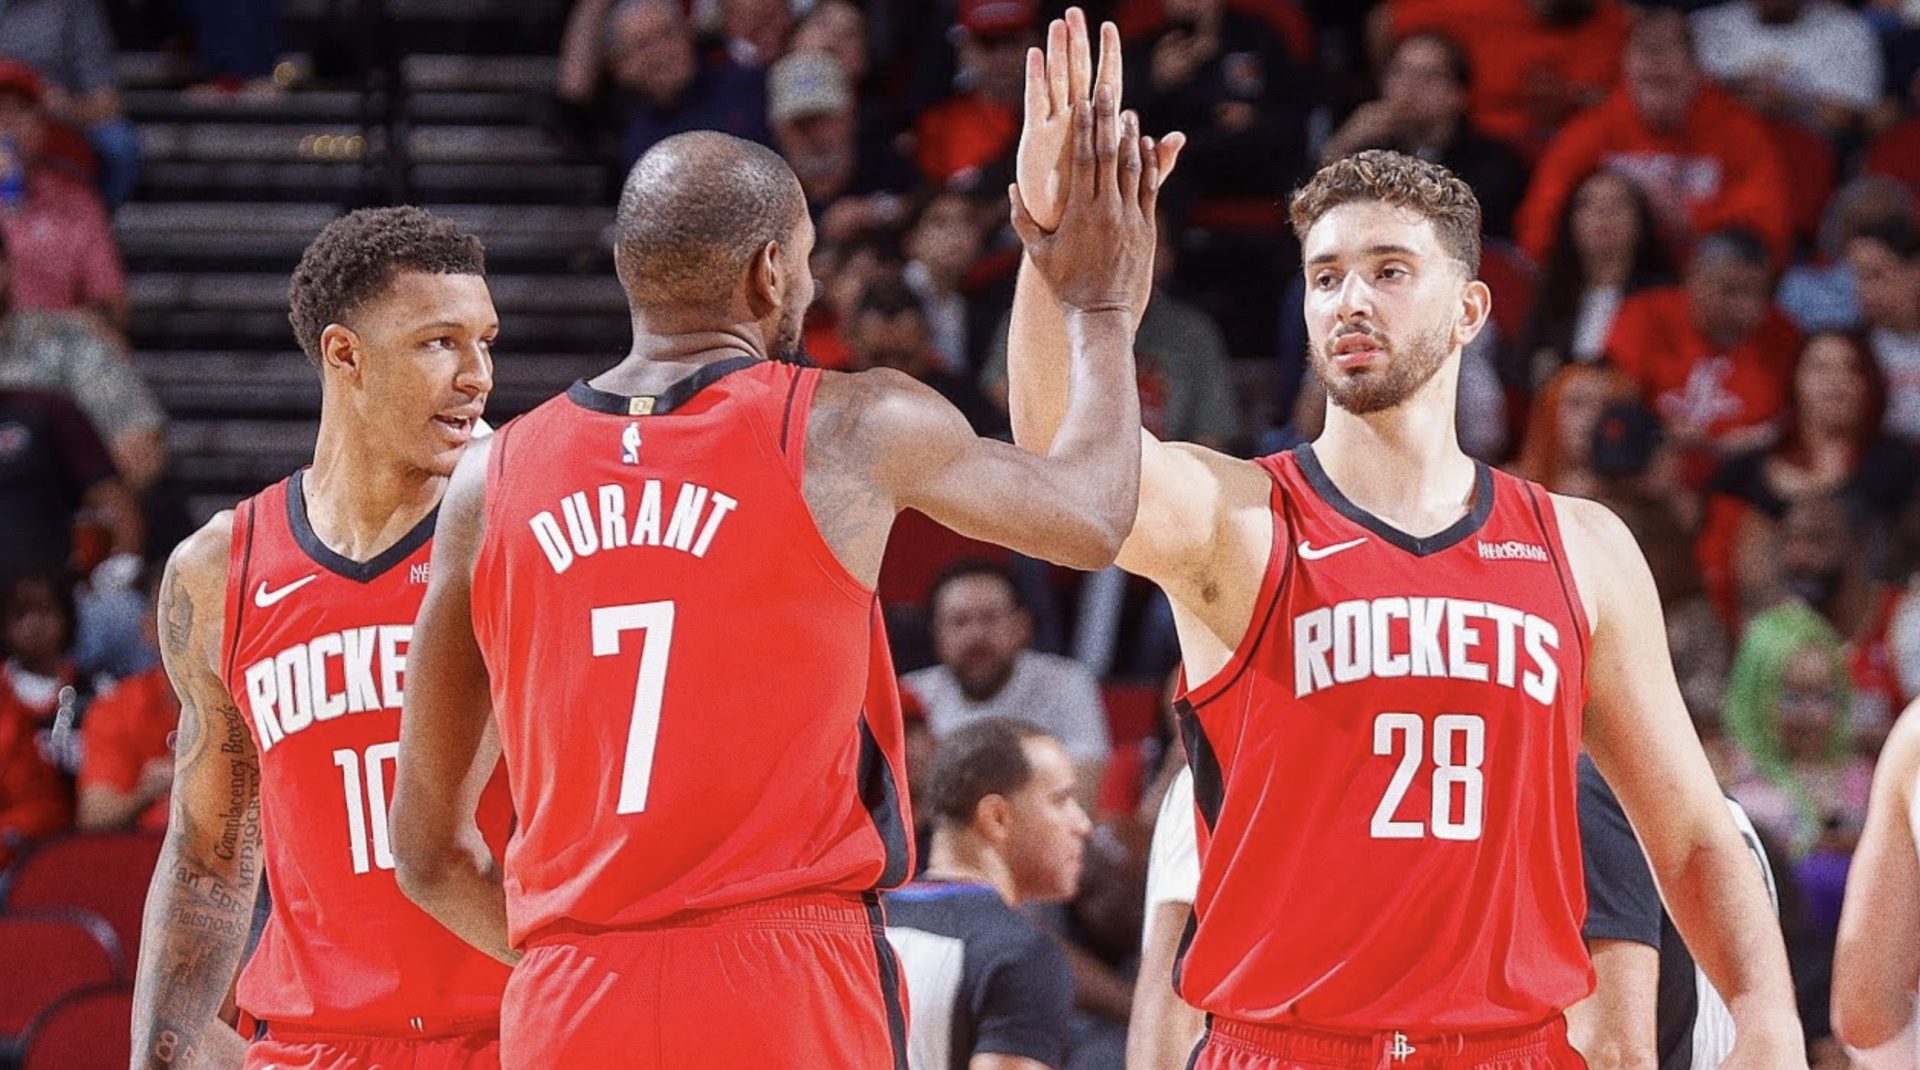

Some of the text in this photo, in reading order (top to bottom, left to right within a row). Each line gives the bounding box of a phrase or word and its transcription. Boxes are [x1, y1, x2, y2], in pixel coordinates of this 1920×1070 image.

[528, 480, 738, 574] DURANT
[1294, 597, 1560, 706] ROCKETS
[216, 704, 244, 756] Breeds
[591, 600, 675, 815] 7
[1370, 713, 1485, 841] 28
